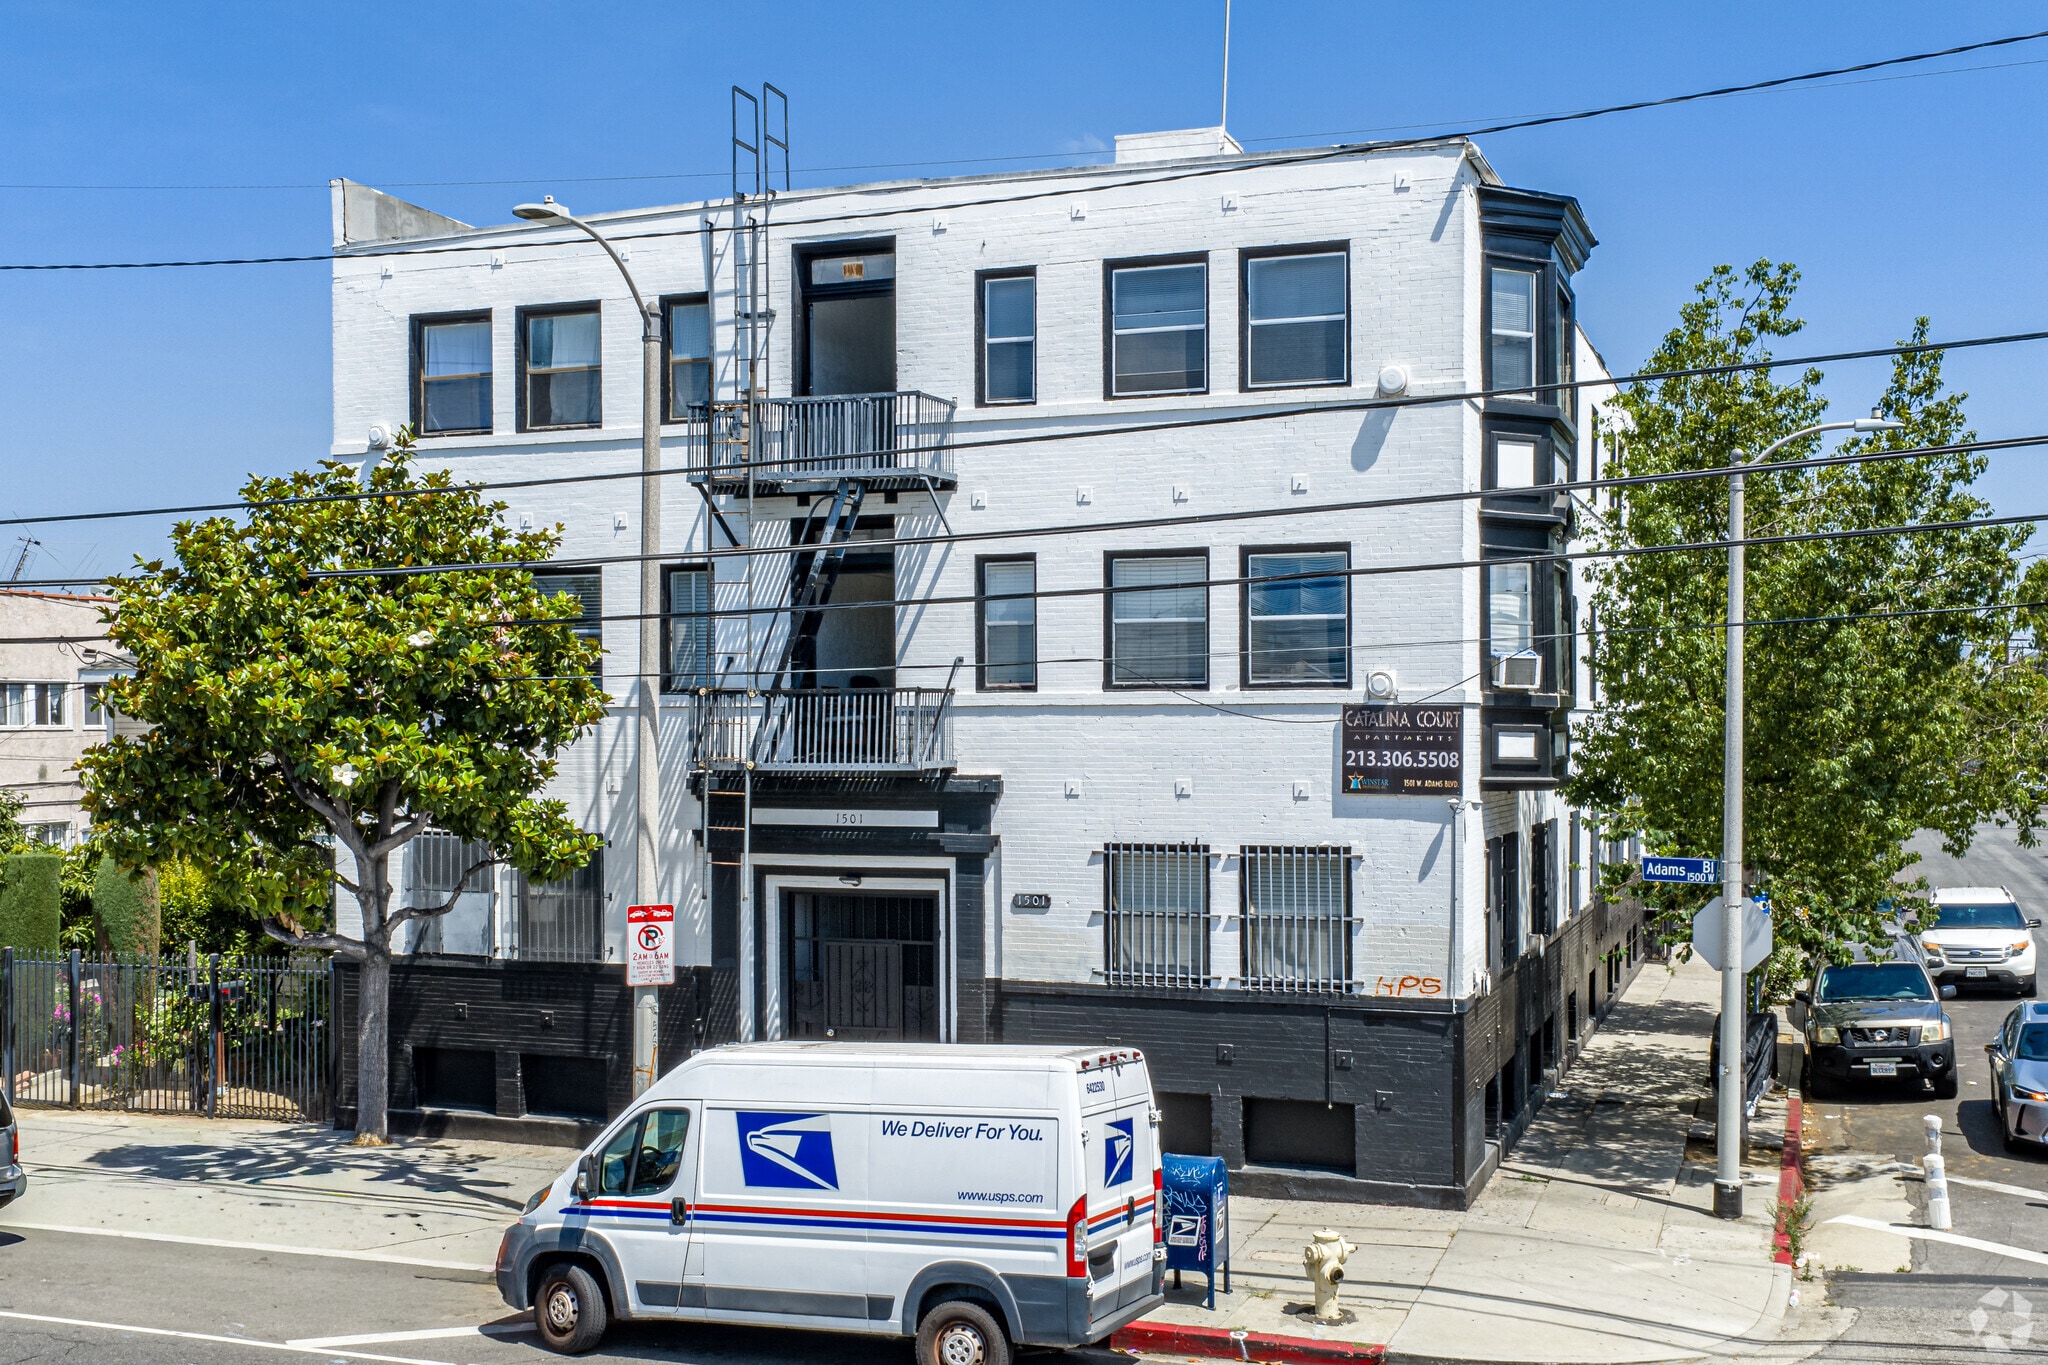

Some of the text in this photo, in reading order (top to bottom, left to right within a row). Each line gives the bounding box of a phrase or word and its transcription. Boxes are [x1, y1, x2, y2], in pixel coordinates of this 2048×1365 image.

[1345, 710, 1461, 728] CATALINA COURT
[1346, 750, 1460, 768] 213.306.5508
[1424, 780, 1444, 788] ADAMS
[836, 813, 863, 824] 1501
[1646, 861, 1714, 876] Adams Bl
[1687, 872, 1715, 882] 1500 W
[1018, 896, 1045, 906] 1501
[632, 952, 648, 961] 2AM
[654, 951, 669, 960] 6AM
[882, 1120, 1044, 1141] We Deliver For You.
[957, 1191, 1044, 1205] www.usps.com
